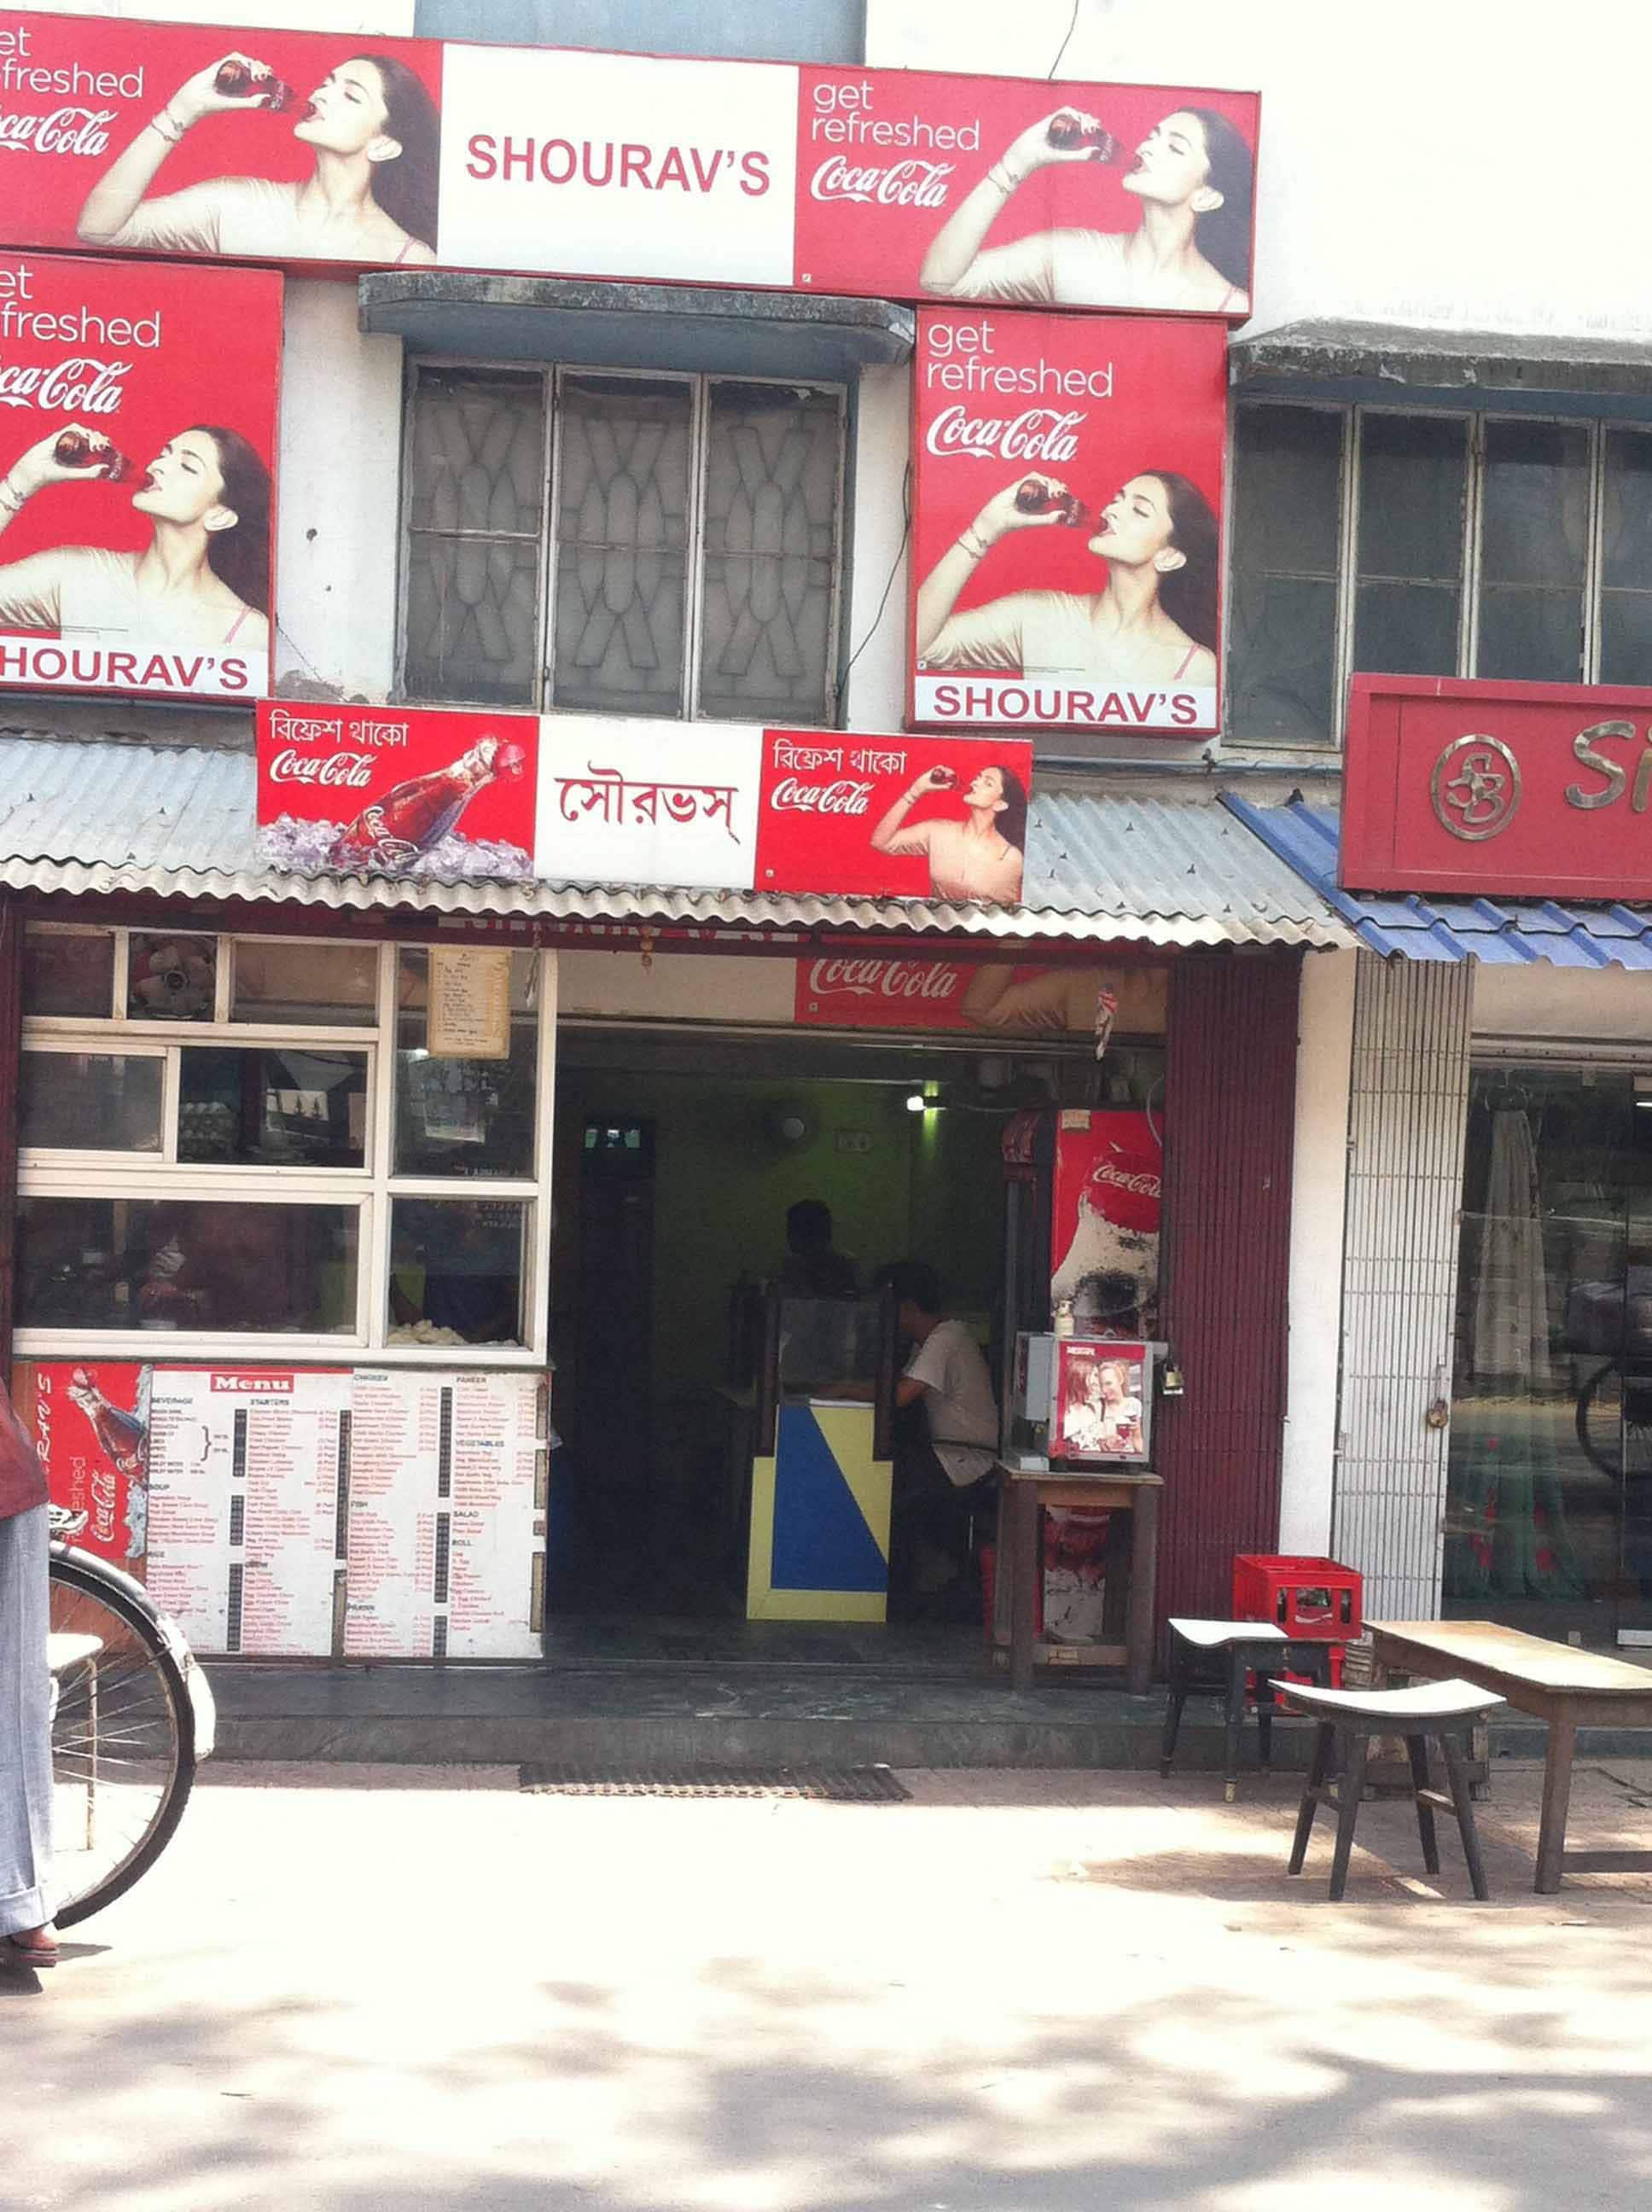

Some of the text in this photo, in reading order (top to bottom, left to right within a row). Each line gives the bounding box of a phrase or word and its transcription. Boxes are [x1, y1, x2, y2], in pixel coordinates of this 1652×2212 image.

[0, 26, 32, 56] et
[0, 58, 144, 98] freshed
[813, 80, 874, 114] get
[0, 106, 119, 156] ca-Cola
[811, 112, 980, 151] refreshed
[466, 134, 770, 196] SHOURAV'S
[811, 155, 957, 207] Coca-Cola
[0, 264, 33, 300] et
[0, 301, 160, 348] freshed
[928, 321, 996, 358] get
[0, 358, 133, 413] ca-Cola
[927, 356, 1113, 397] refreshed
[927, 405, 1088, 461] Coca-Cola
[0, 645, 248, 690] HOURAV'S
[934, 685, 1198, 725] SHOURAV'S
[348, 719, 410, 747] থাকো
[270, 749, 377, 787] Coca-Cola
[849, 748, 907, 774] থাকো
[771, 777, 875, 814] Coca-Cola
[215, 1376, 290, 1391] Menu
